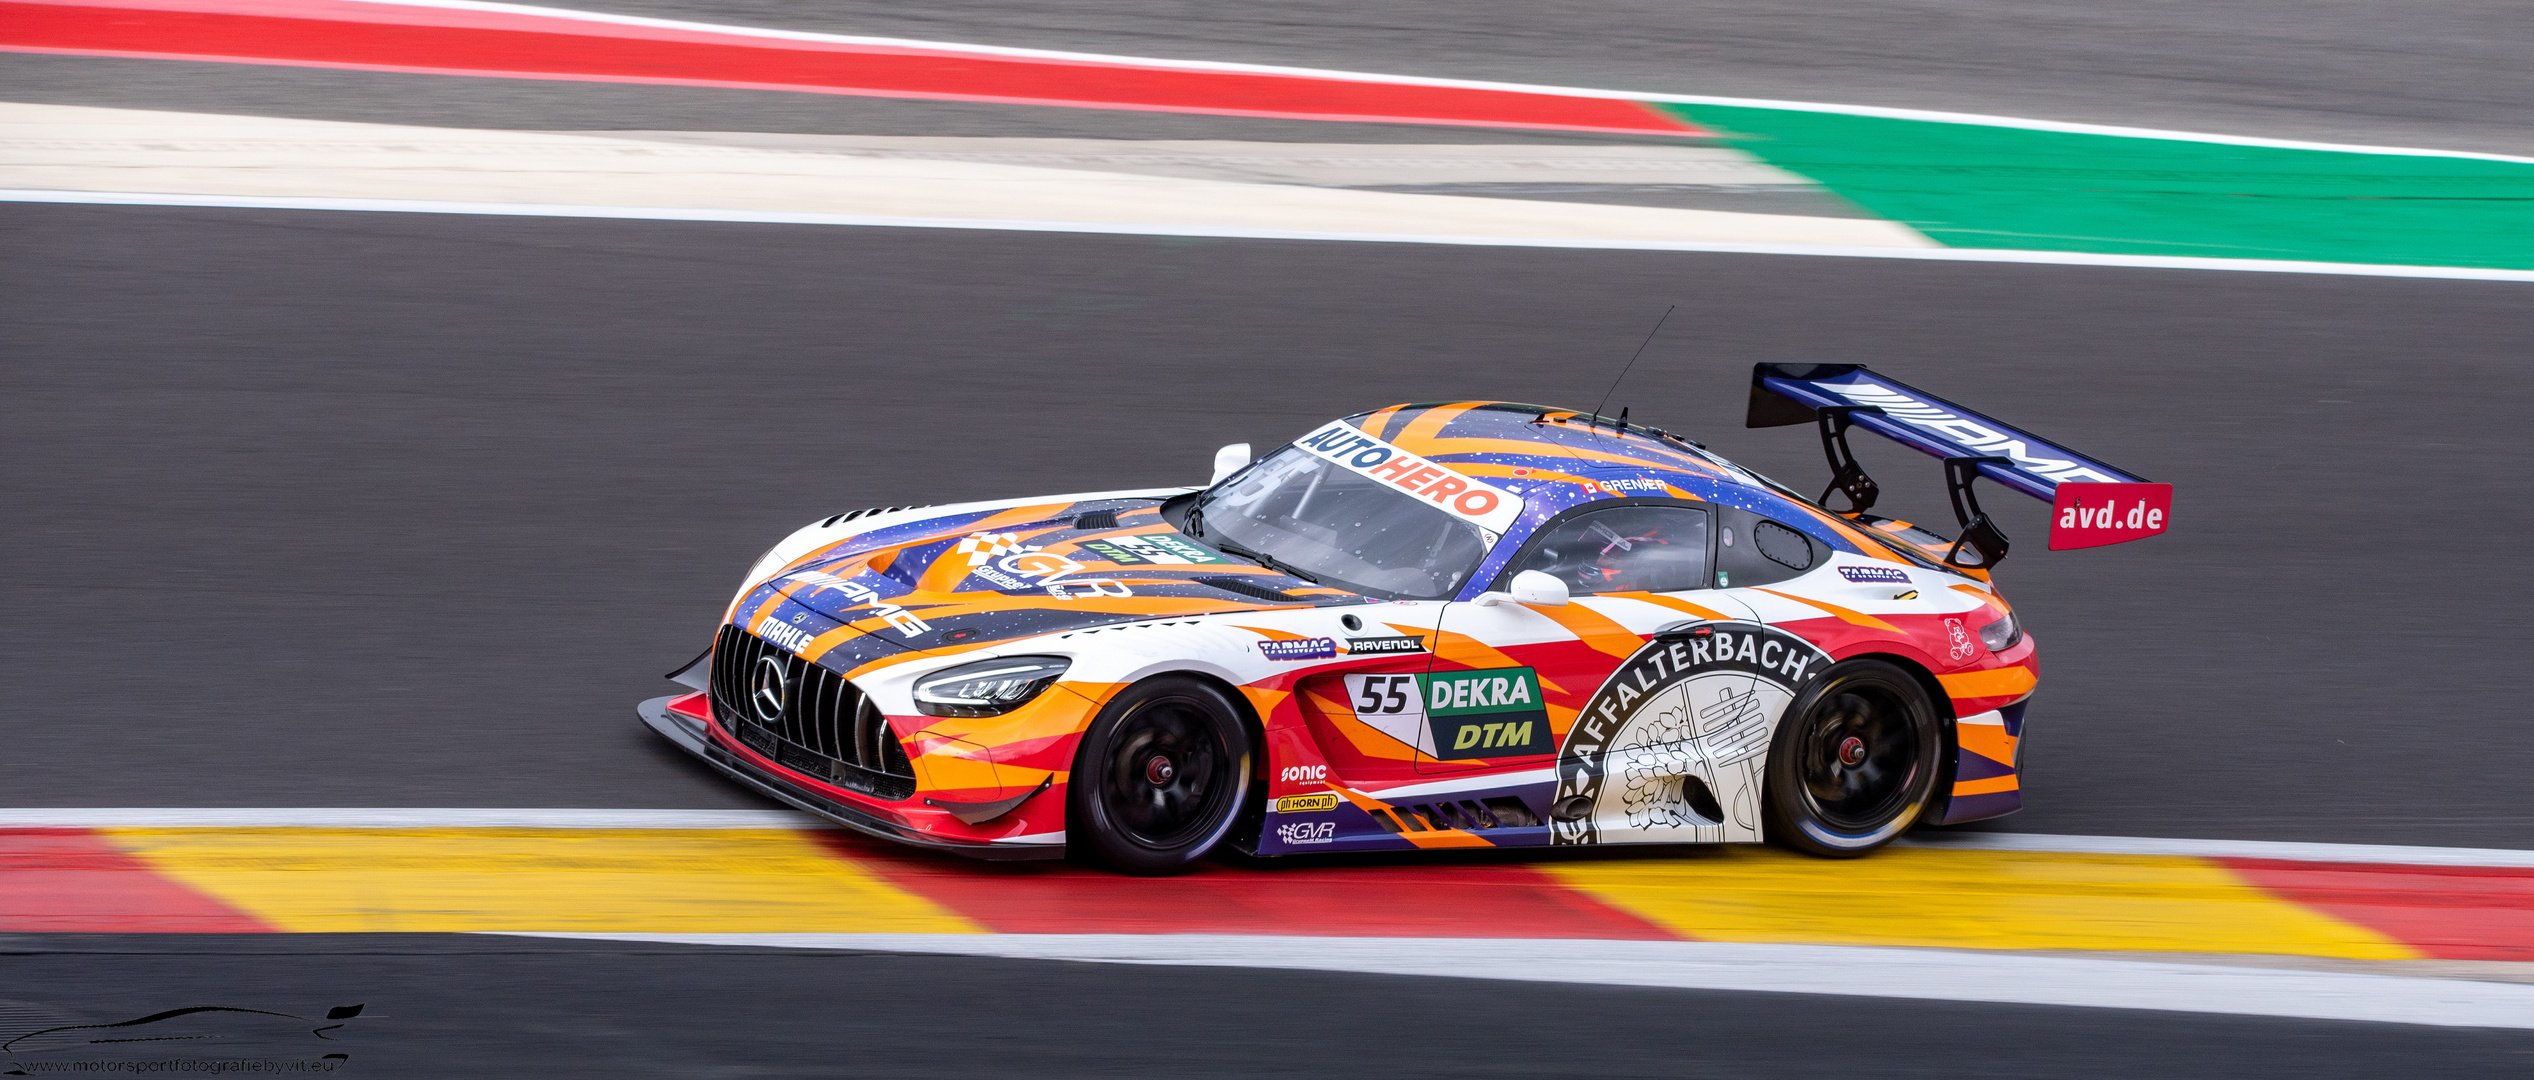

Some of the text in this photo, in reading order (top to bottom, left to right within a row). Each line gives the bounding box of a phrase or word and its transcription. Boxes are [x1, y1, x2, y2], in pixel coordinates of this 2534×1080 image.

[1301, 427, 1499, 516] AUTOHERO
[1600, 479, 1668, 491] GRENIER
[2060, 499, 2163, 529] avd.de
[1085, 543, 1141, 563] DTM
[1120, 544, 1173, 556] 55
[1143, 535, 1216, 563] DEKRA
[998, 552, 1133, 599] GVR
[1840, 568, 1905, 580] TARMAC
[828, 582, 932, 639] AMG
[756, 616, 815, 654] MAHLE
[1260, 640, 1331, 655] TARMAC
[1357, 676, 1410, 713] 55
[1431, 675, 1531, 709] DEKRA
[1573, 633, 1809, 768] AFFALTERBACH
[1453, 721, 1533, 750] DTM
[1292, 798, 1320, 808] HORN
[1293, 822, 1336, 839] GVR
